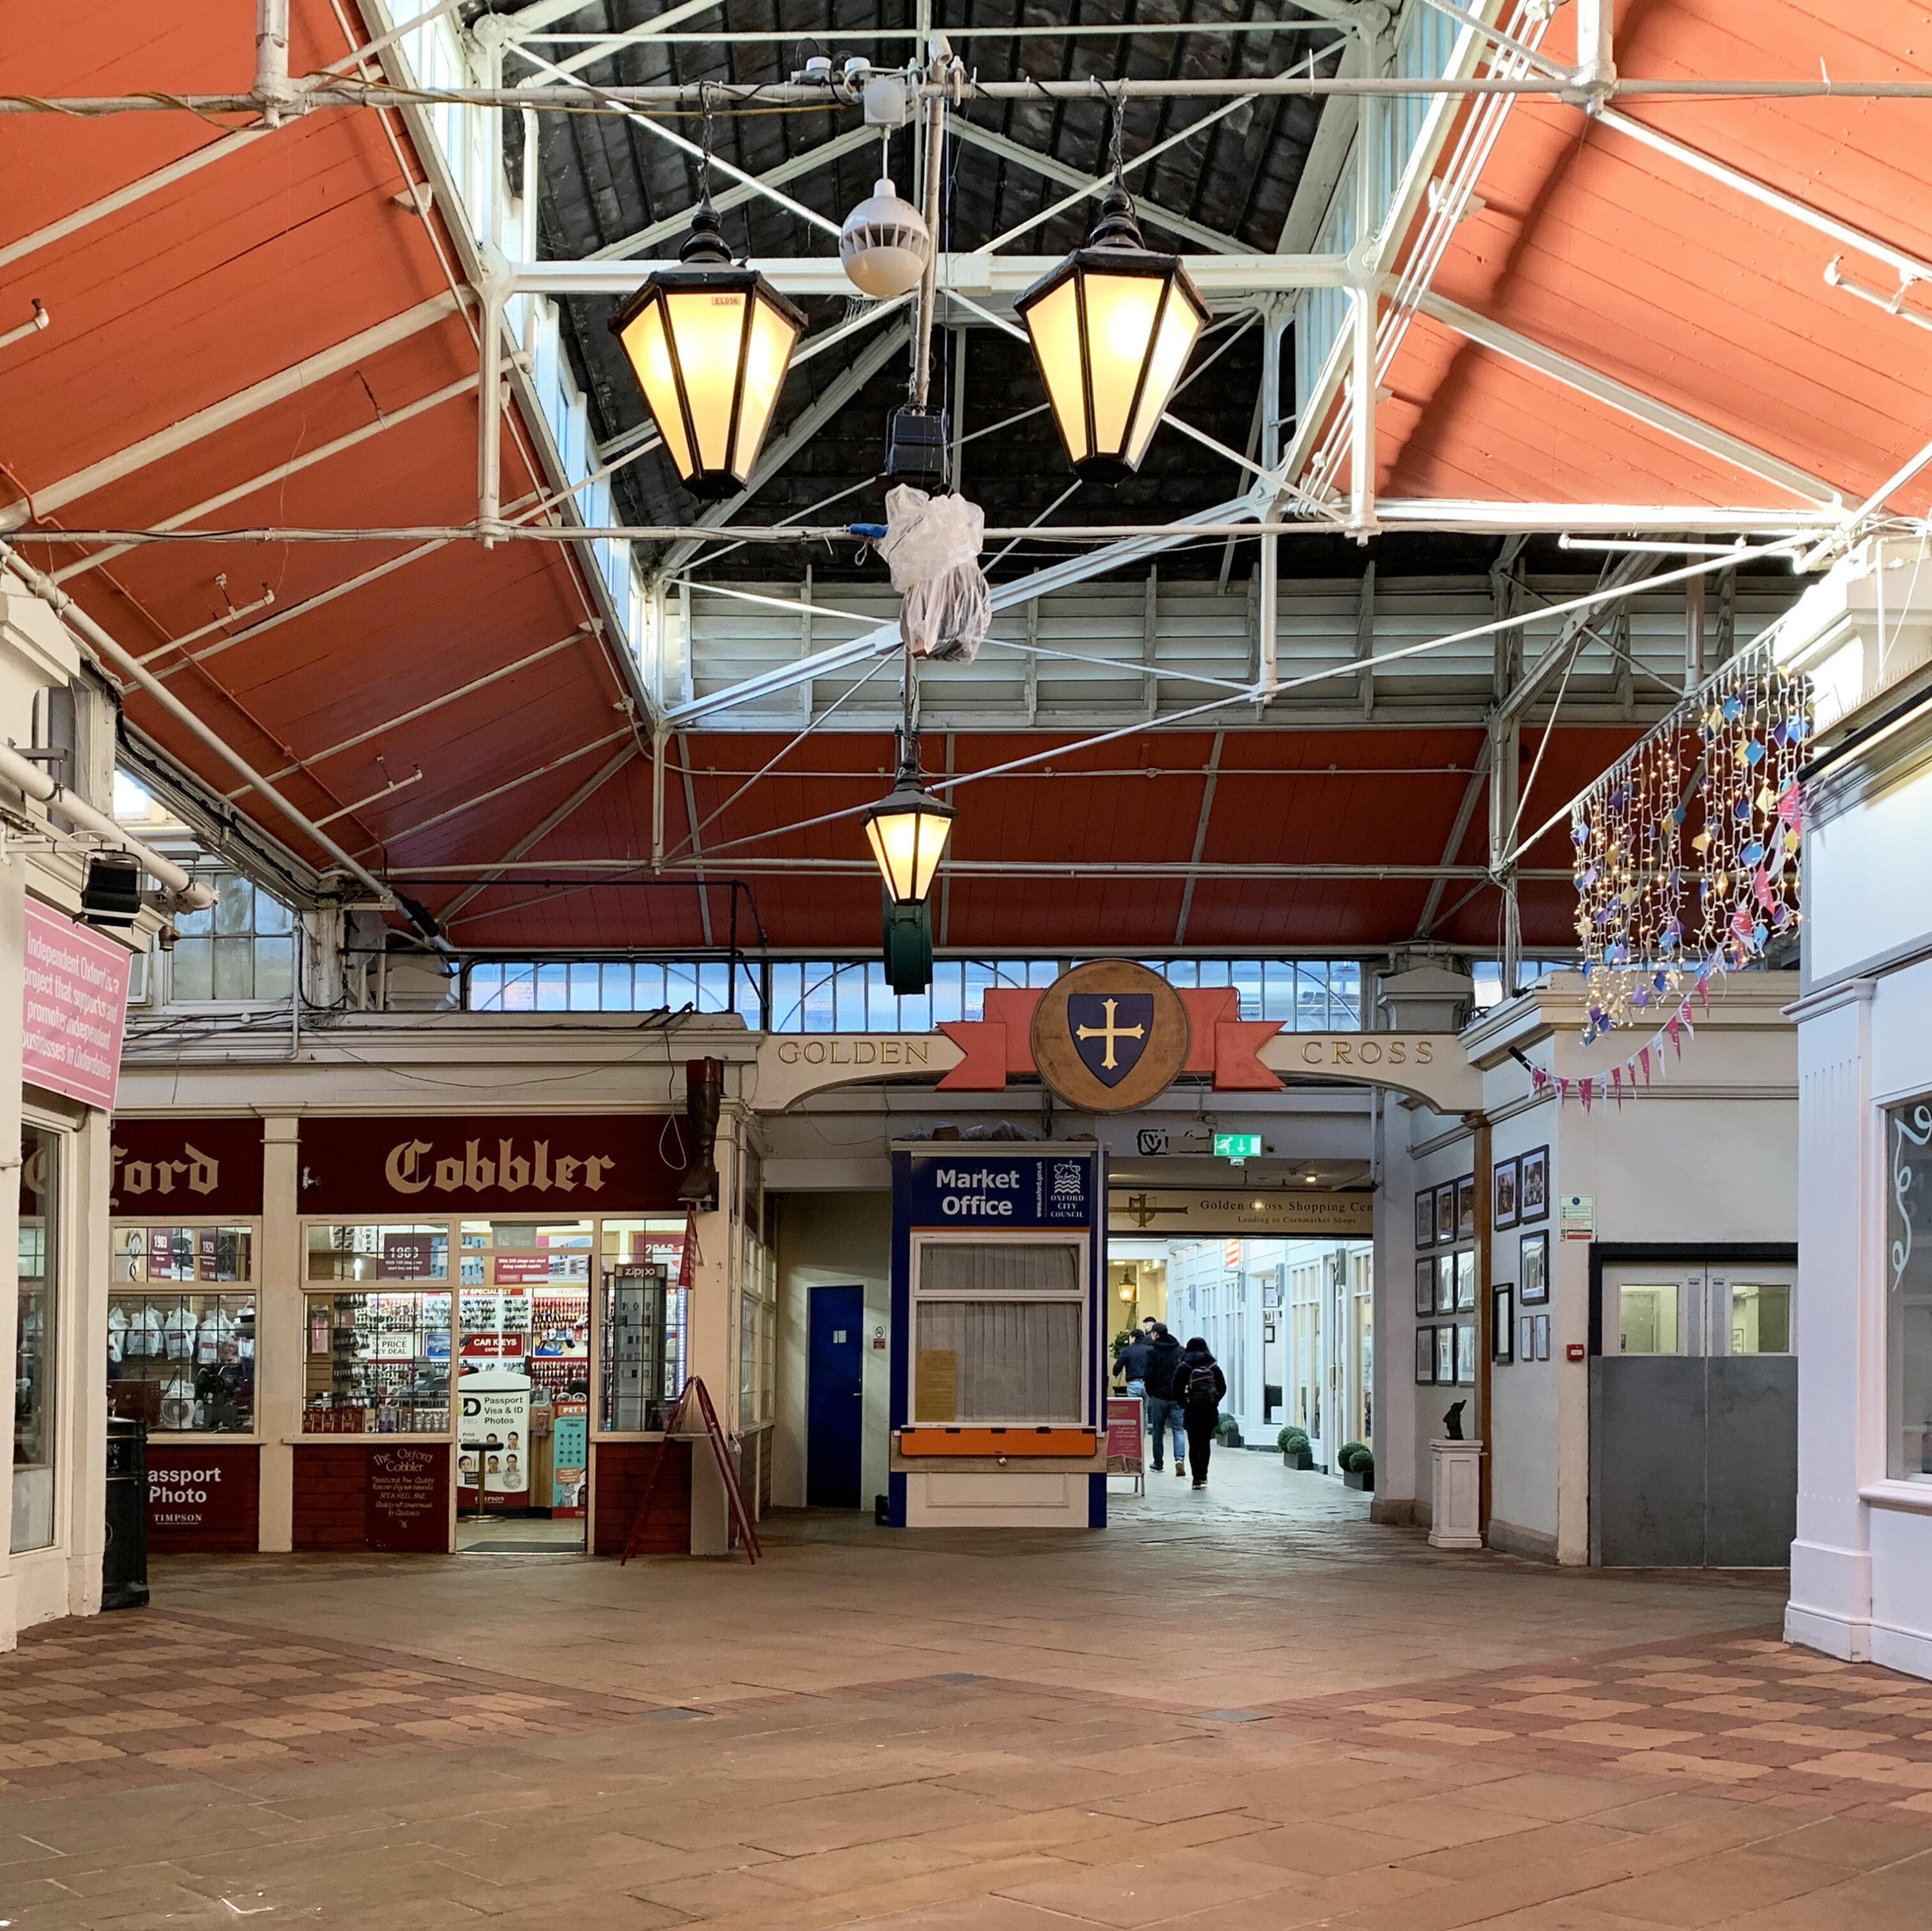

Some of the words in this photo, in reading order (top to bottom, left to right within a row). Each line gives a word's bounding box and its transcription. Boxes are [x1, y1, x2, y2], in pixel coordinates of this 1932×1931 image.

[28, 930, 79, 977] Independent
[81, 957, 106, 989] Oxford
[106, 970, 113, 991] is
[114, 978, 119, 994] a
[23, 966, 53, 995] project
[55, 977, 72, 1004] that
[73, 988, 106, 1018] supports
[106, 1003, 118, 1024] and
[28, 1000, 67, 1030] promotes
[67, 1012, 111, 1051] independent
[67, 1042, 75, 1064] in
[74, 1045, 111, 1080] Oxfordshire
[778, 1041, 929, 1064] GOLDEN
[1302, 1041, 1432, 1064] CROSS
[110, 1142, 219, 1208] ford
[385, 1138, 616, 1194] Cobbler
[936, 1169, 1019, 1188] Market
[942, 1196, 1012, 1215] Office
[1200, 1200, 1244, 1210] Golden
[1249, 1200, 1283, 1210] Coss
[1289, 1201, 1345, 1214] Shopping
[1350, 1202, 1373, 1211] Cen
[625, 1268, 655, 1277] zippo
[484, 1397, 523, 1405] Passport
[372, 1453, 391, 1465] The
[397, 1448, 433, 1463] Oxford
[386, 1460, 424, 1472] Cobbler
[147, 1467, 221, 1486] assport
[149, 1486, 207, 1503] Photo
